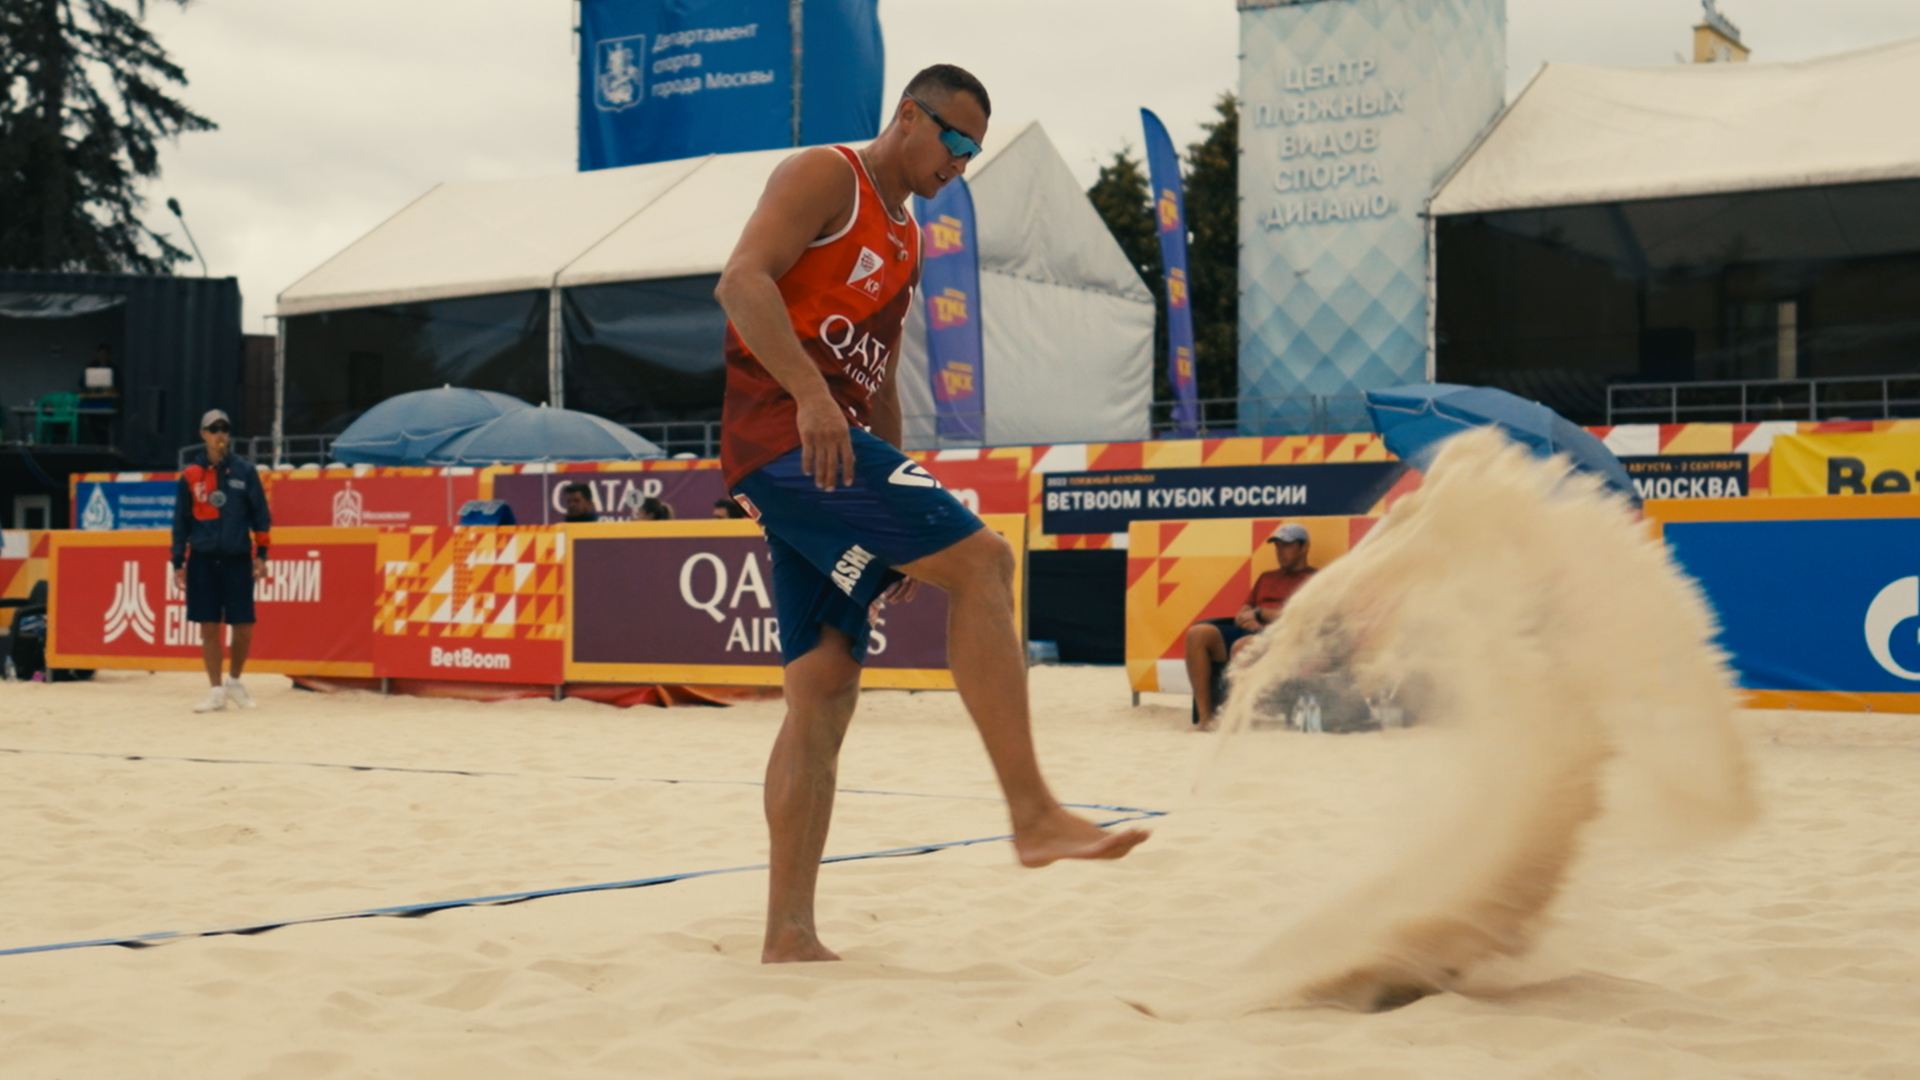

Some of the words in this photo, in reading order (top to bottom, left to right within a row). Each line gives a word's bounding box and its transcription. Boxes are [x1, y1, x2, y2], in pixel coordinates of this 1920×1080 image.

[652, 23, 758, 53] Департамент
[652, 53, 703, 74] спорта
[1284, 58, 1376, 91] ЦЕНТР
[651, 77, 702, 98] города
[705, 69, 775, 89] Москвы
[1254, 89, 1404, 128] ПЛЯЖНЫХ
[1279, 128, 1379, 160] ВИДОВ
[1273, 158, 1382, 193] СПОРТА
[1629, 462, 1672, 472] АВГУСТА
[1827, 456, 1920, 495] Be
[1148, 487, 1215, 508] КУБОК
[1219, 485, 1307, 507] РОССИИ
[1633, 477, 1741, 499] МОСКВА
[725, 617, 888, 655] AIRS
[431, 646, 511, 669] BetBoom
